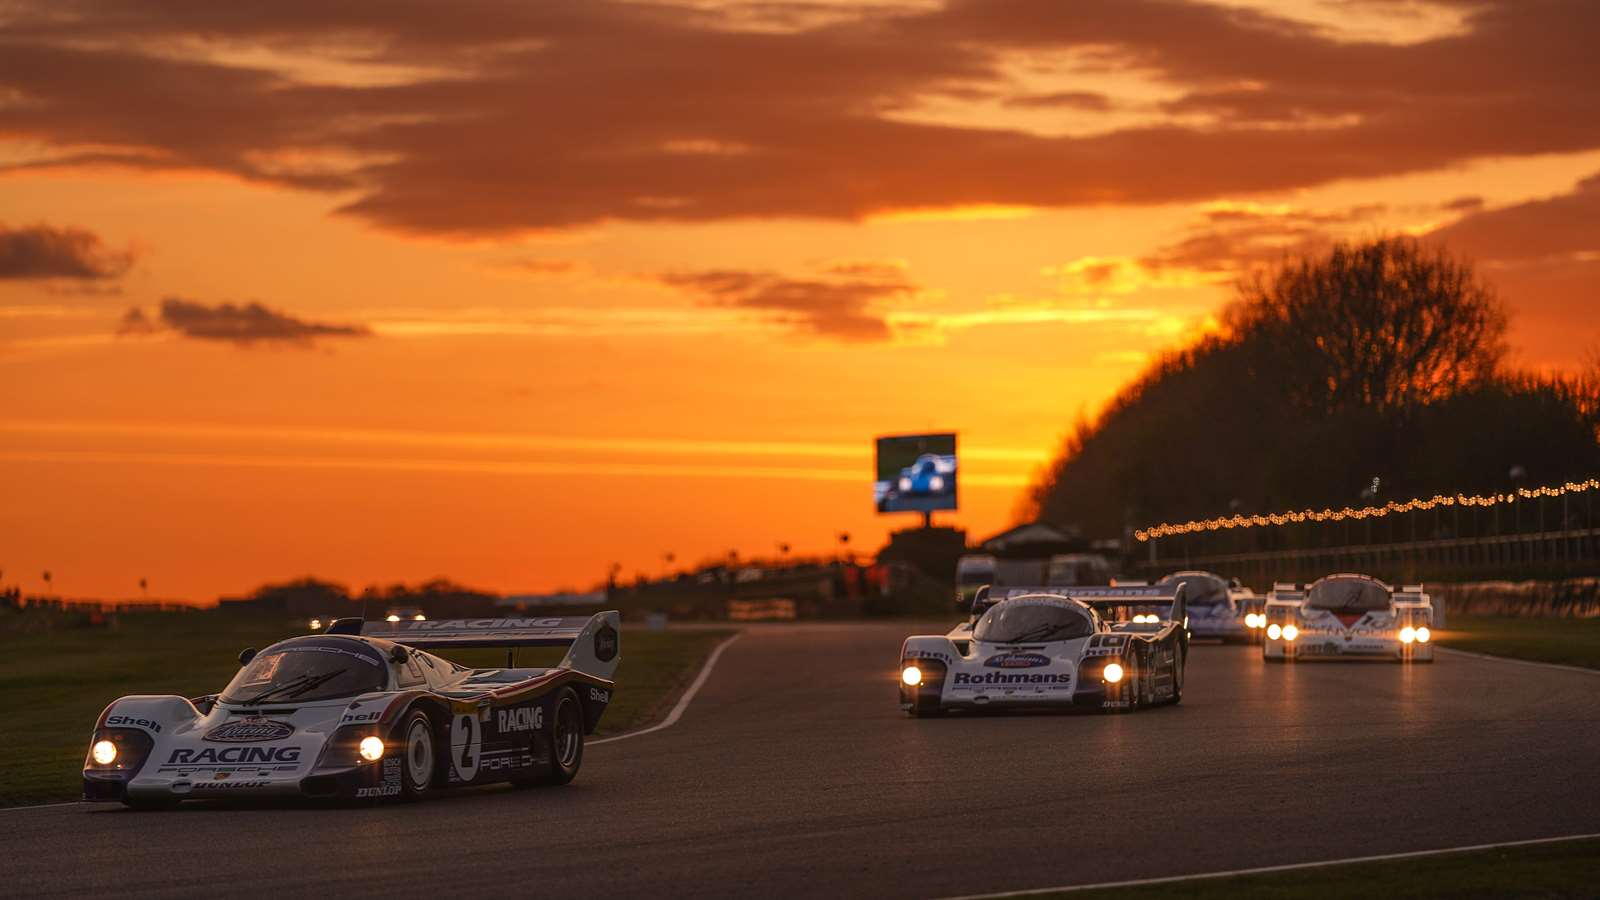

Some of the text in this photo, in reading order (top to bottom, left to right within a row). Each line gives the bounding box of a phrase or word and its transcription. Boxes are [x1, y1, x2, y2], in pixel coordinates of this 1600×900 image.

[407, 617, 563, 630] RACING
[1086, 648, 1122, 656] hell
[953, 671, 1071, 684] Rothmans
[590, 687, 609, 704] Shell
[343, 711, 382, 722] hell
[497, 706, 544, 733] RACING
[108, 716, 162, 733] Shell
[461, 715, 473, 768] 2
[167, 747, 302, 763] RACING
[356, 785, 402, 798] DUNLOP
